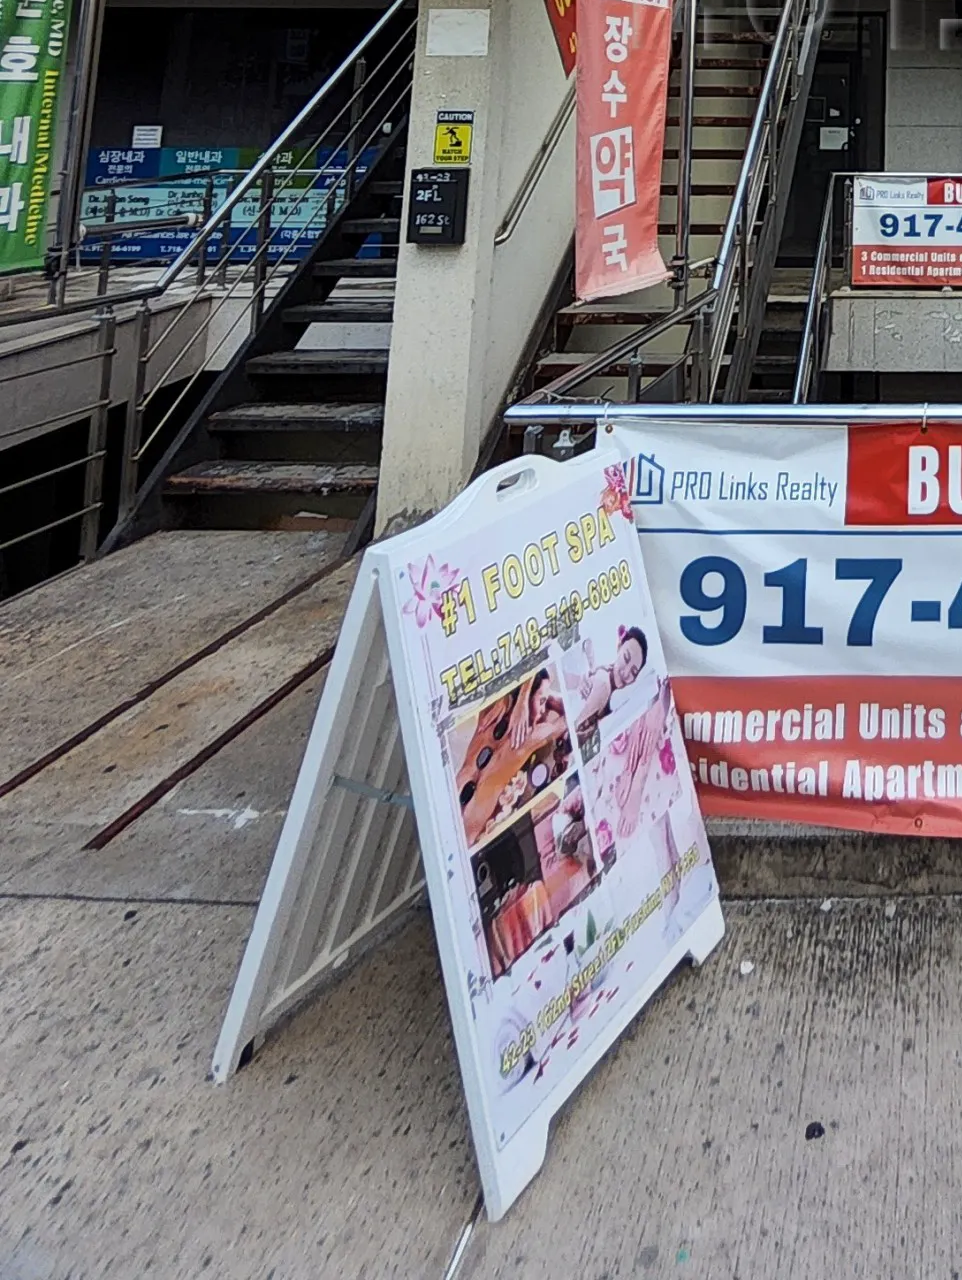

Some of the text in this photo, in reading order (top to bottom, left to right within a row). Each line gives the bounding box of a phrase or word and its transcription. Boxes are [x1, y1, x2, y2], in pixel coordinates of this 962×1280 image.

[48, 19, 65, 58] MD
[438, 112, 473, 121] CAUTION
[175, 150, 223, 164] 일반내과
[415, 214, 436, 225] 162
[861, 251, 868, 261] 3
[870, 250, 928, 262] Commercial
[930, 252, 957, 262] Units
[861, 265, 866, 276] 1
[869, 265, 924, 277] Residential
[670, 470, 838, 508] PRO Links Realty
[440, 505, 616, 637] #1 FOOT SPA
[858, 702, 946, 740] Units
[500, 1020, 536, 1076] 42-23
[570, 945, 606, 997] Street
